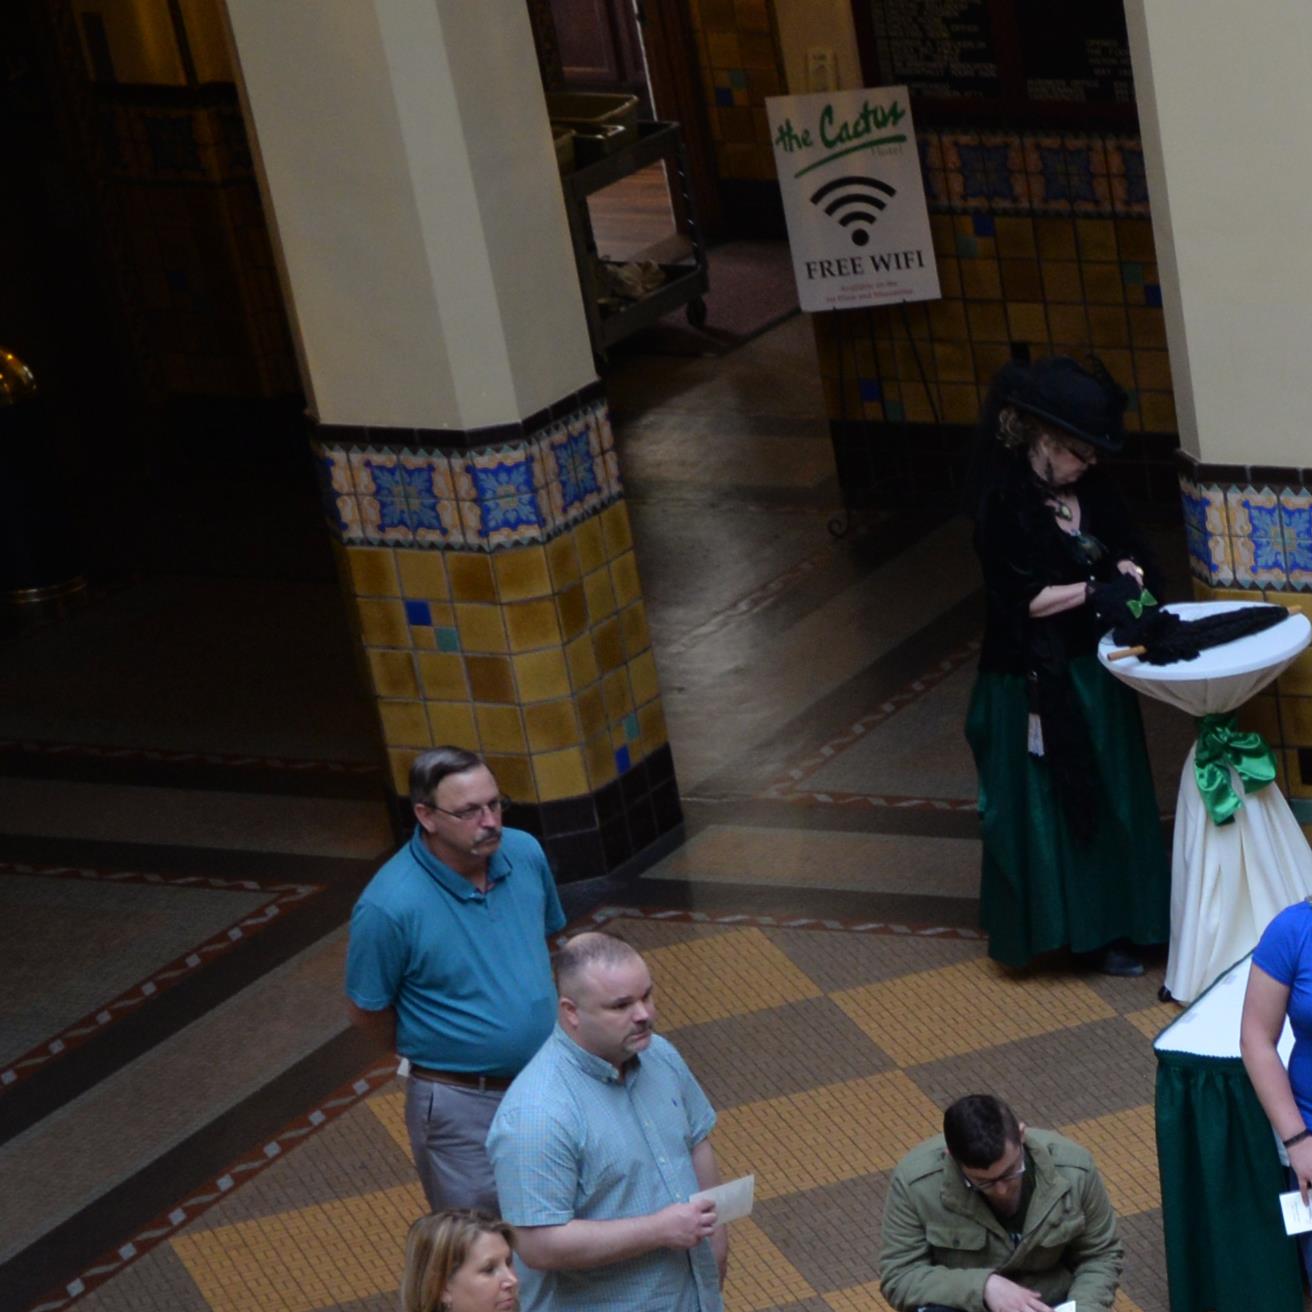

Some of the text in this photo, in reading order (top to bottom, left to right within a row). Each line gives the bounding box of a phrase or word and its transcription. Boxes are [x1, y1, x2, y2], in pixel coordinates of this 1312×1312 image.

[775, 100, 906, 152] the Cactus
[805, 250, 925, 280] FREE WIFI
